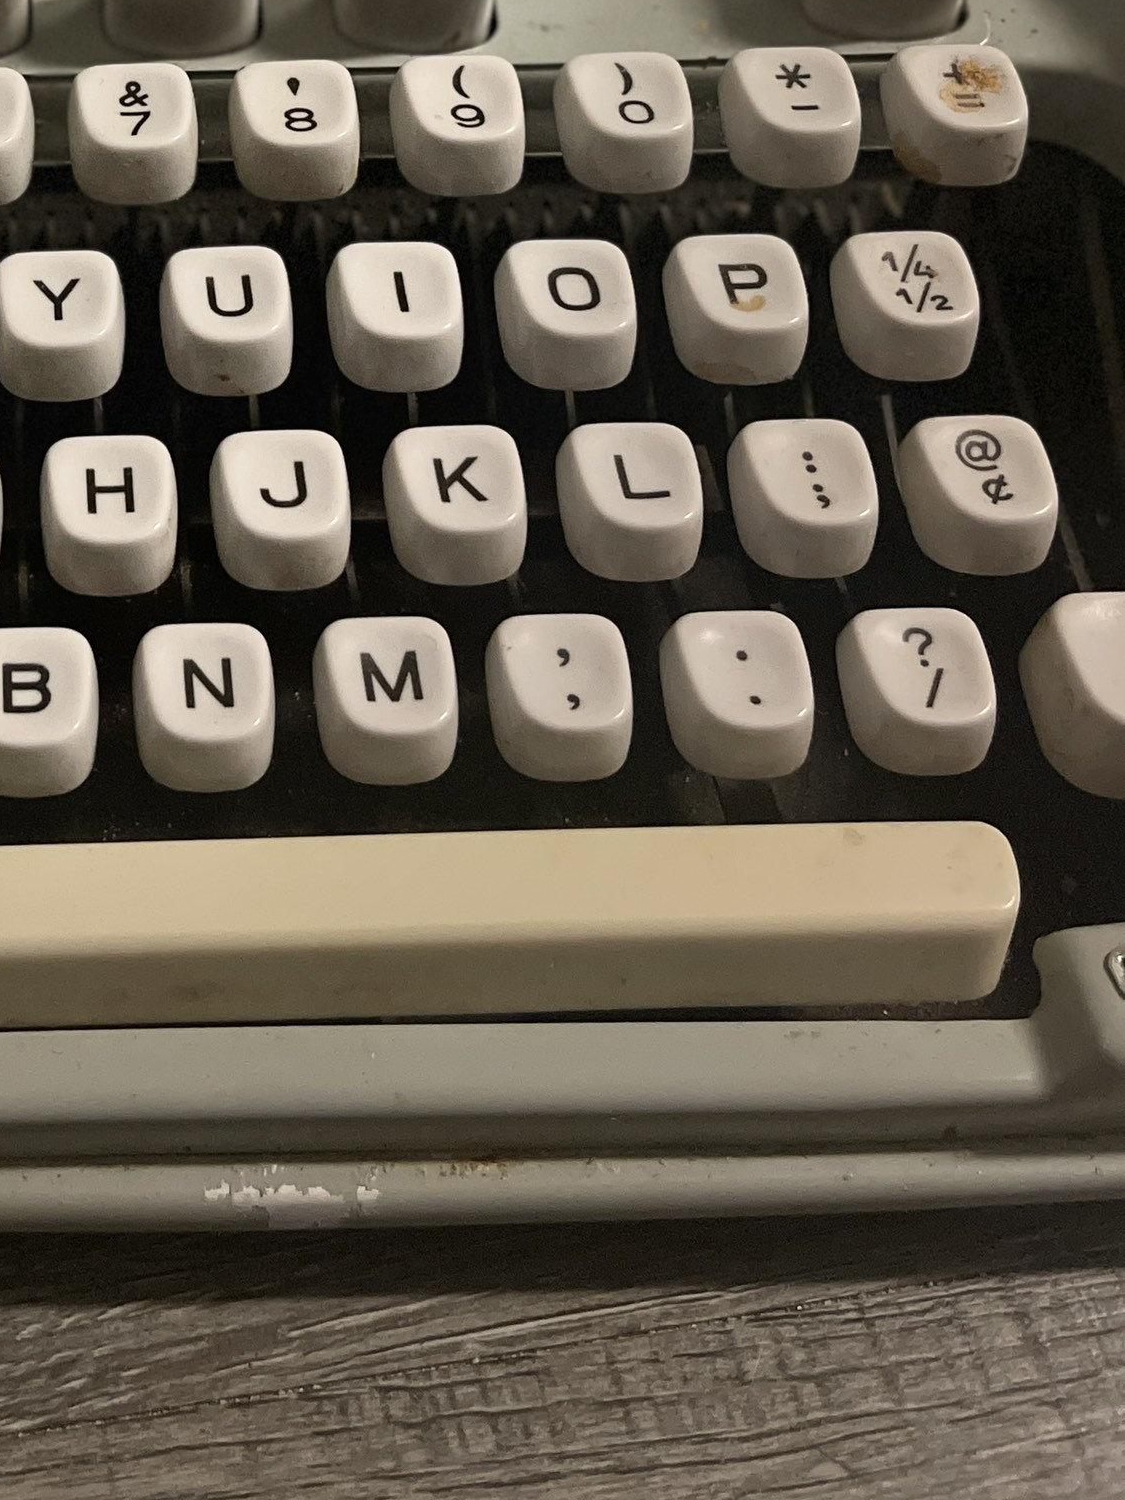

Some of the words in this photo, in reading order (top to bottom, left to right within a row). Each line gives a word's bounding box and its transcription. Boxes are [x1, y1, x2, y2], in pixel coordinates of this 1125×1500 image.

[118, 80, 149, 108] &
[618, 100, 655, 125] 0
[119, 110, 151, 137] 7
[283, 107, 318, 133] 8
[450, 103, 486, 129] 9
[32, 278, 81, 321] Y
[205, 274, 254, 318] U
[393, 271, 410, 313] I
[547, 266, 601, 312] O
[718, 263, 768, 305] P
[955, 429, 1002, 472] @
[85, 466, 136, 515] H
[259, 460, 308, 509] J
[432, 456, 489, 503] K
[613, 454, 671, 500] L
[903, 627, 933, 668] ?
[2, 662, 52, 714] B
[183, 657, 235, 709] N
[360, 650, 424, 703] M
